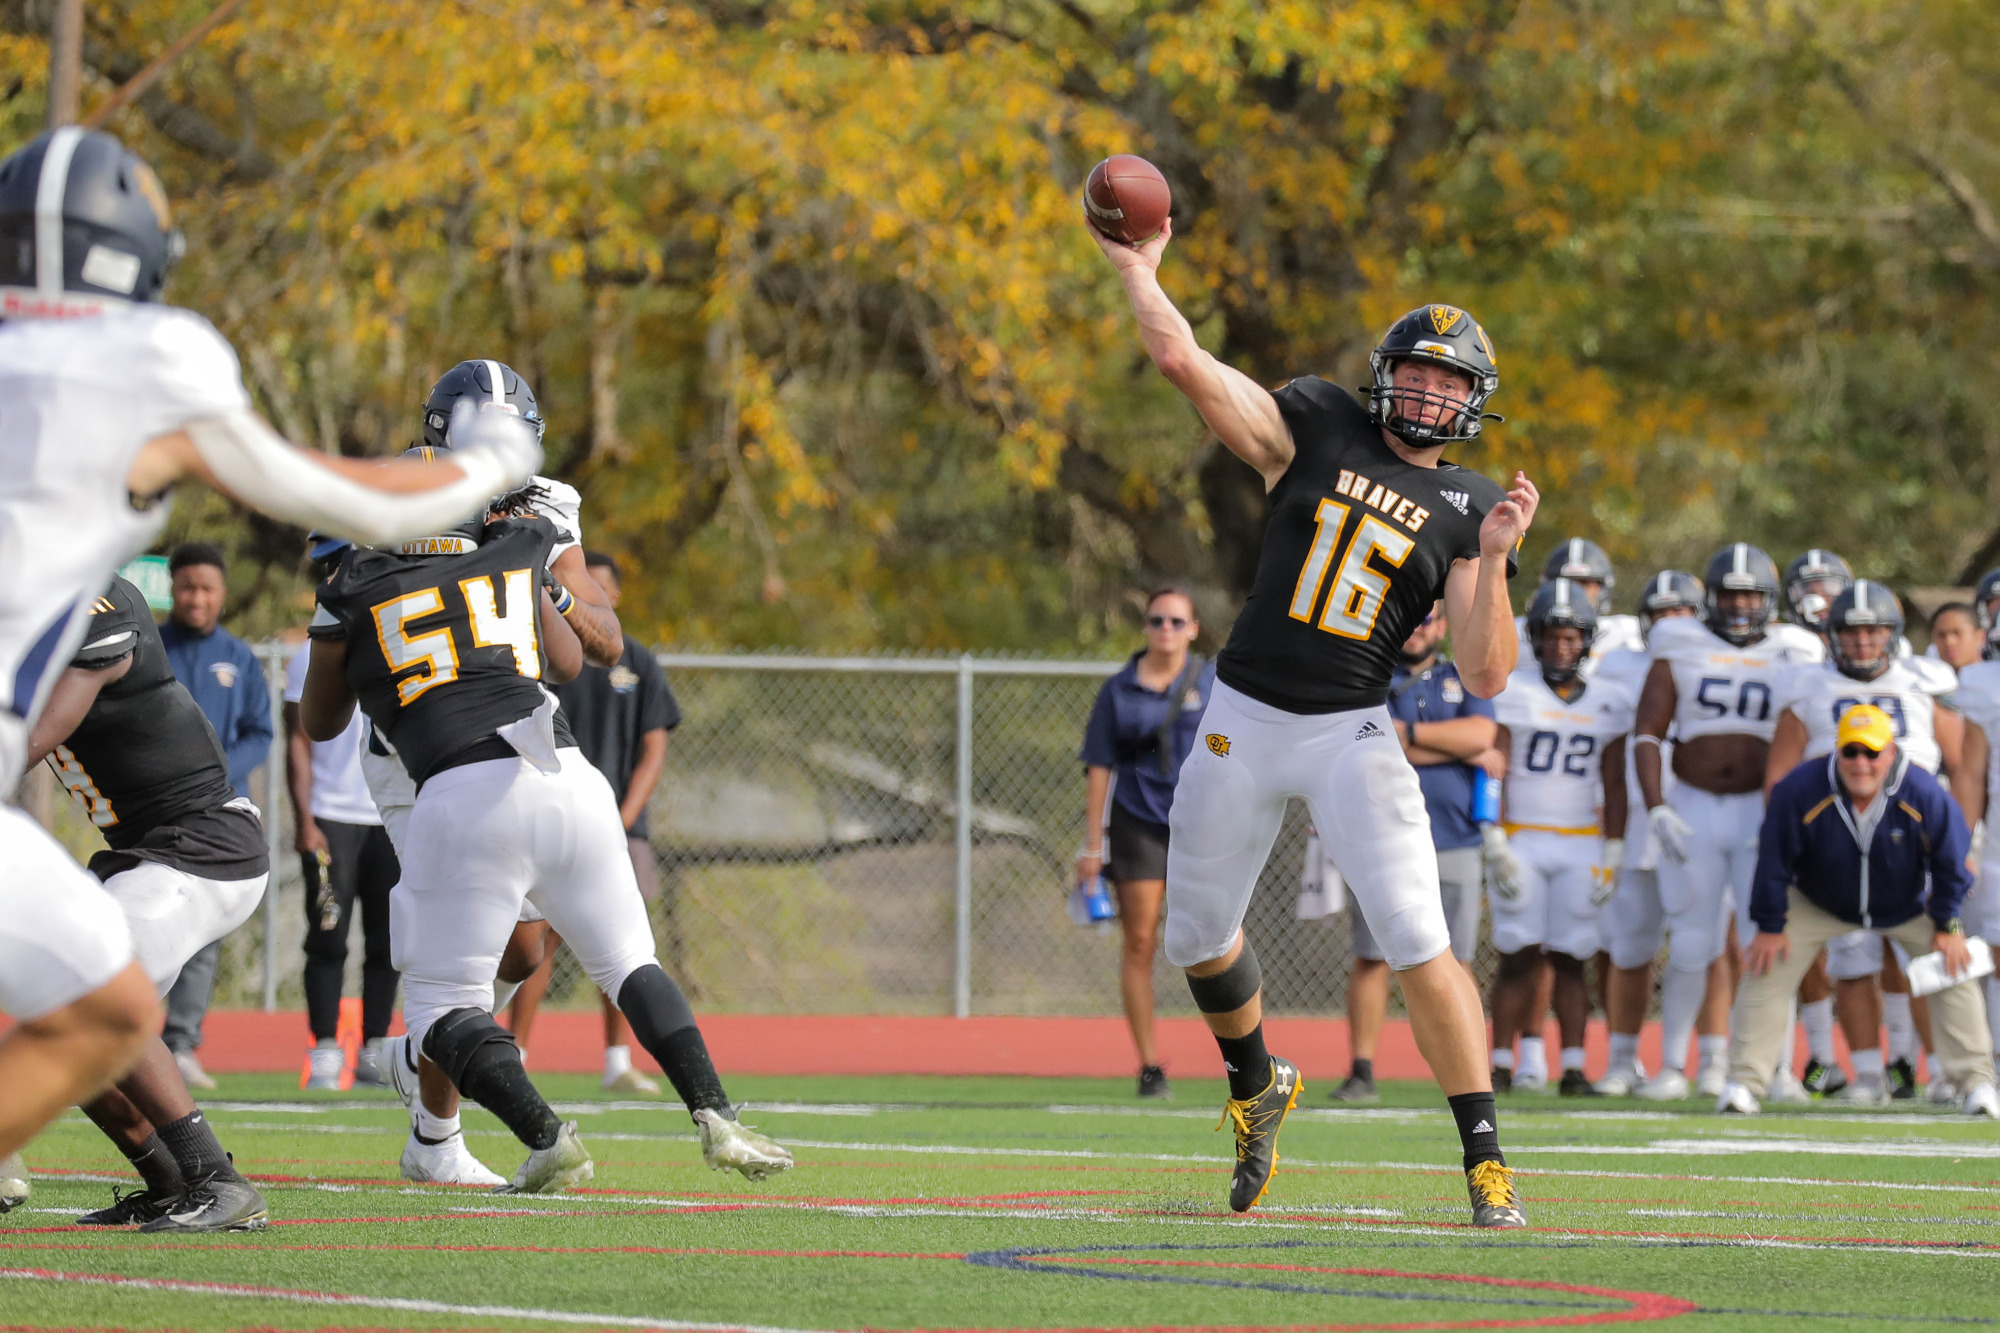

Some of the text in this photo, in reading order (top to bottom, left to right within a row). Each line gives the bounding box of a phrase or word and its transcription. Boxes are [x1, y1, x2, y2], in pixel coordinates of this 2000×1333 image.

[1334, 469, 1431, 532] BRAVES
[1439, 490, 1469, 515] adidas
[402, 538, 463, 554] OTTAWA
[1288, 497, 1416, 641] 16
[370, 568, 541, 707] 54
[1698, 677, 1771, 721] 50
[1355, 729, 1386, 741] adidas
[1527, 730, 1595, 776] 02
